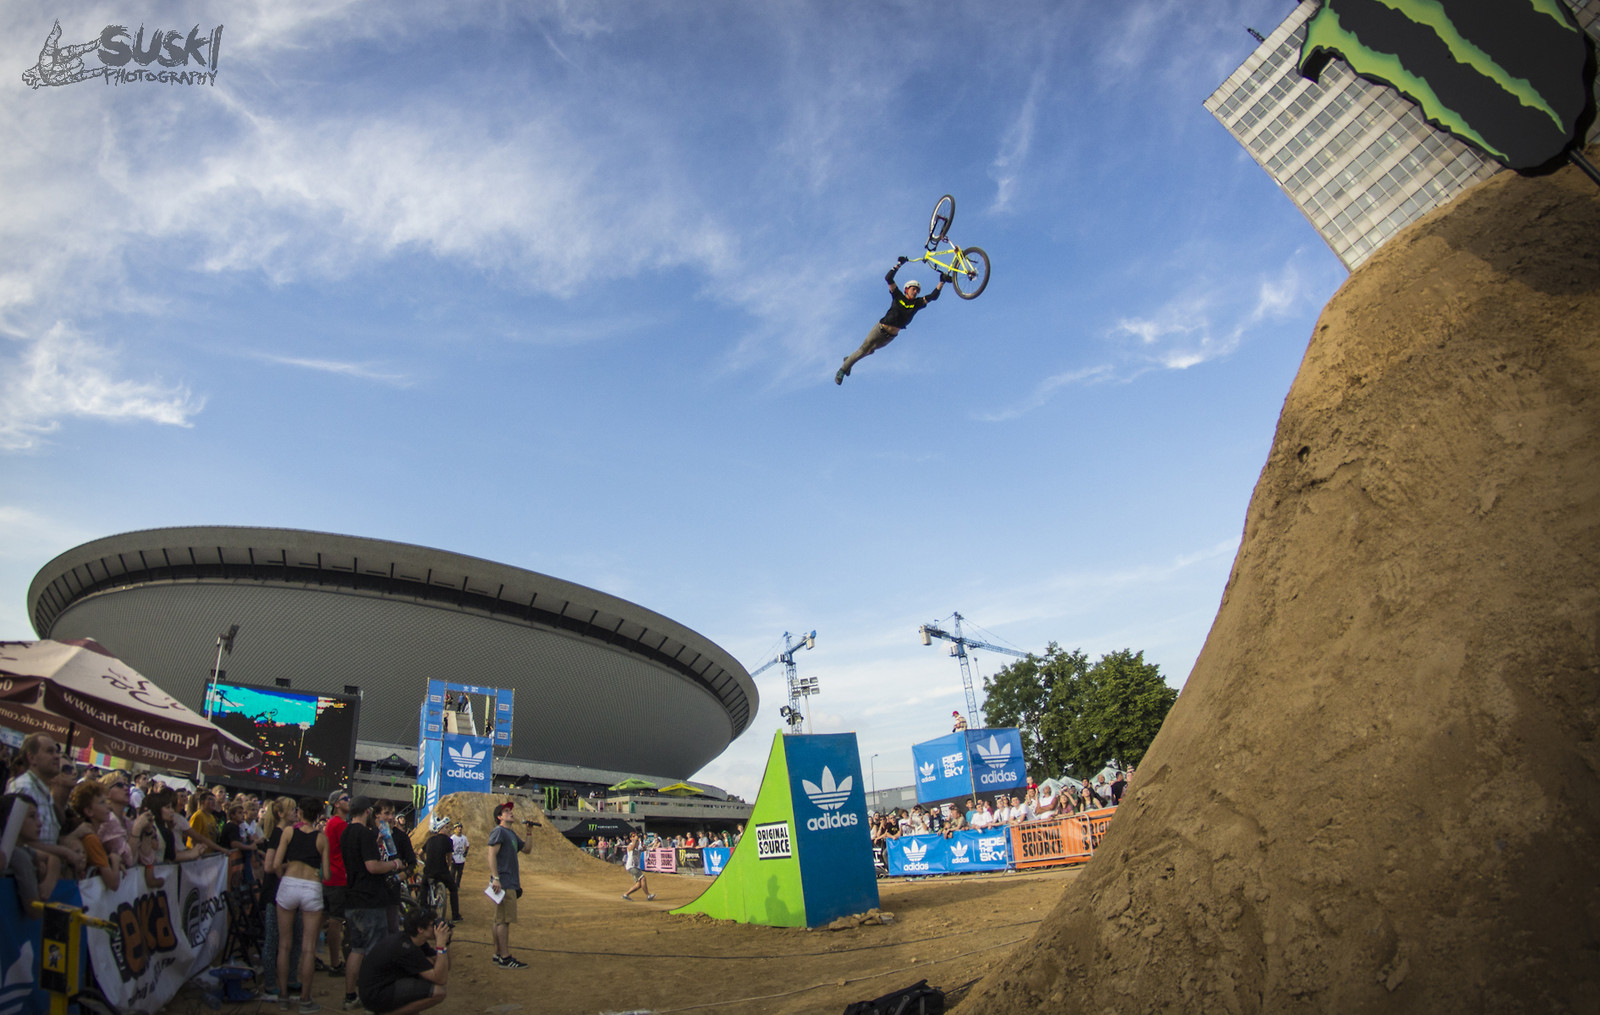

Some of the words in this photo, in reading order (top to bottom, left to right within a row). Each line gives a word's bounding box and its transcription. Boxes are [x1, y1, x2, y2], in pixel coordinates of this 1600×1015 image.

[63, 691, 199, 748] www.art-cafe.com.pl
[942, 752, 964, 765] RIDE
[446, 768, 485, 781] adidas
[944, 765, 964, 778] SKY
[981, 770, 1018, 784] adidas
[921, 775, 936, 783] adidas
[807, 811, 859, 831] adidas
[757, 827, 789, 841] ORIGINAL
[758, 838, 790, 855] SOURCE
[978, 836, 1006, 848] RIDE
[952, 856, 970, 864] adidas
[979, 850, 1006, 862] SKY
[903, 861, 929, 871] adidas
